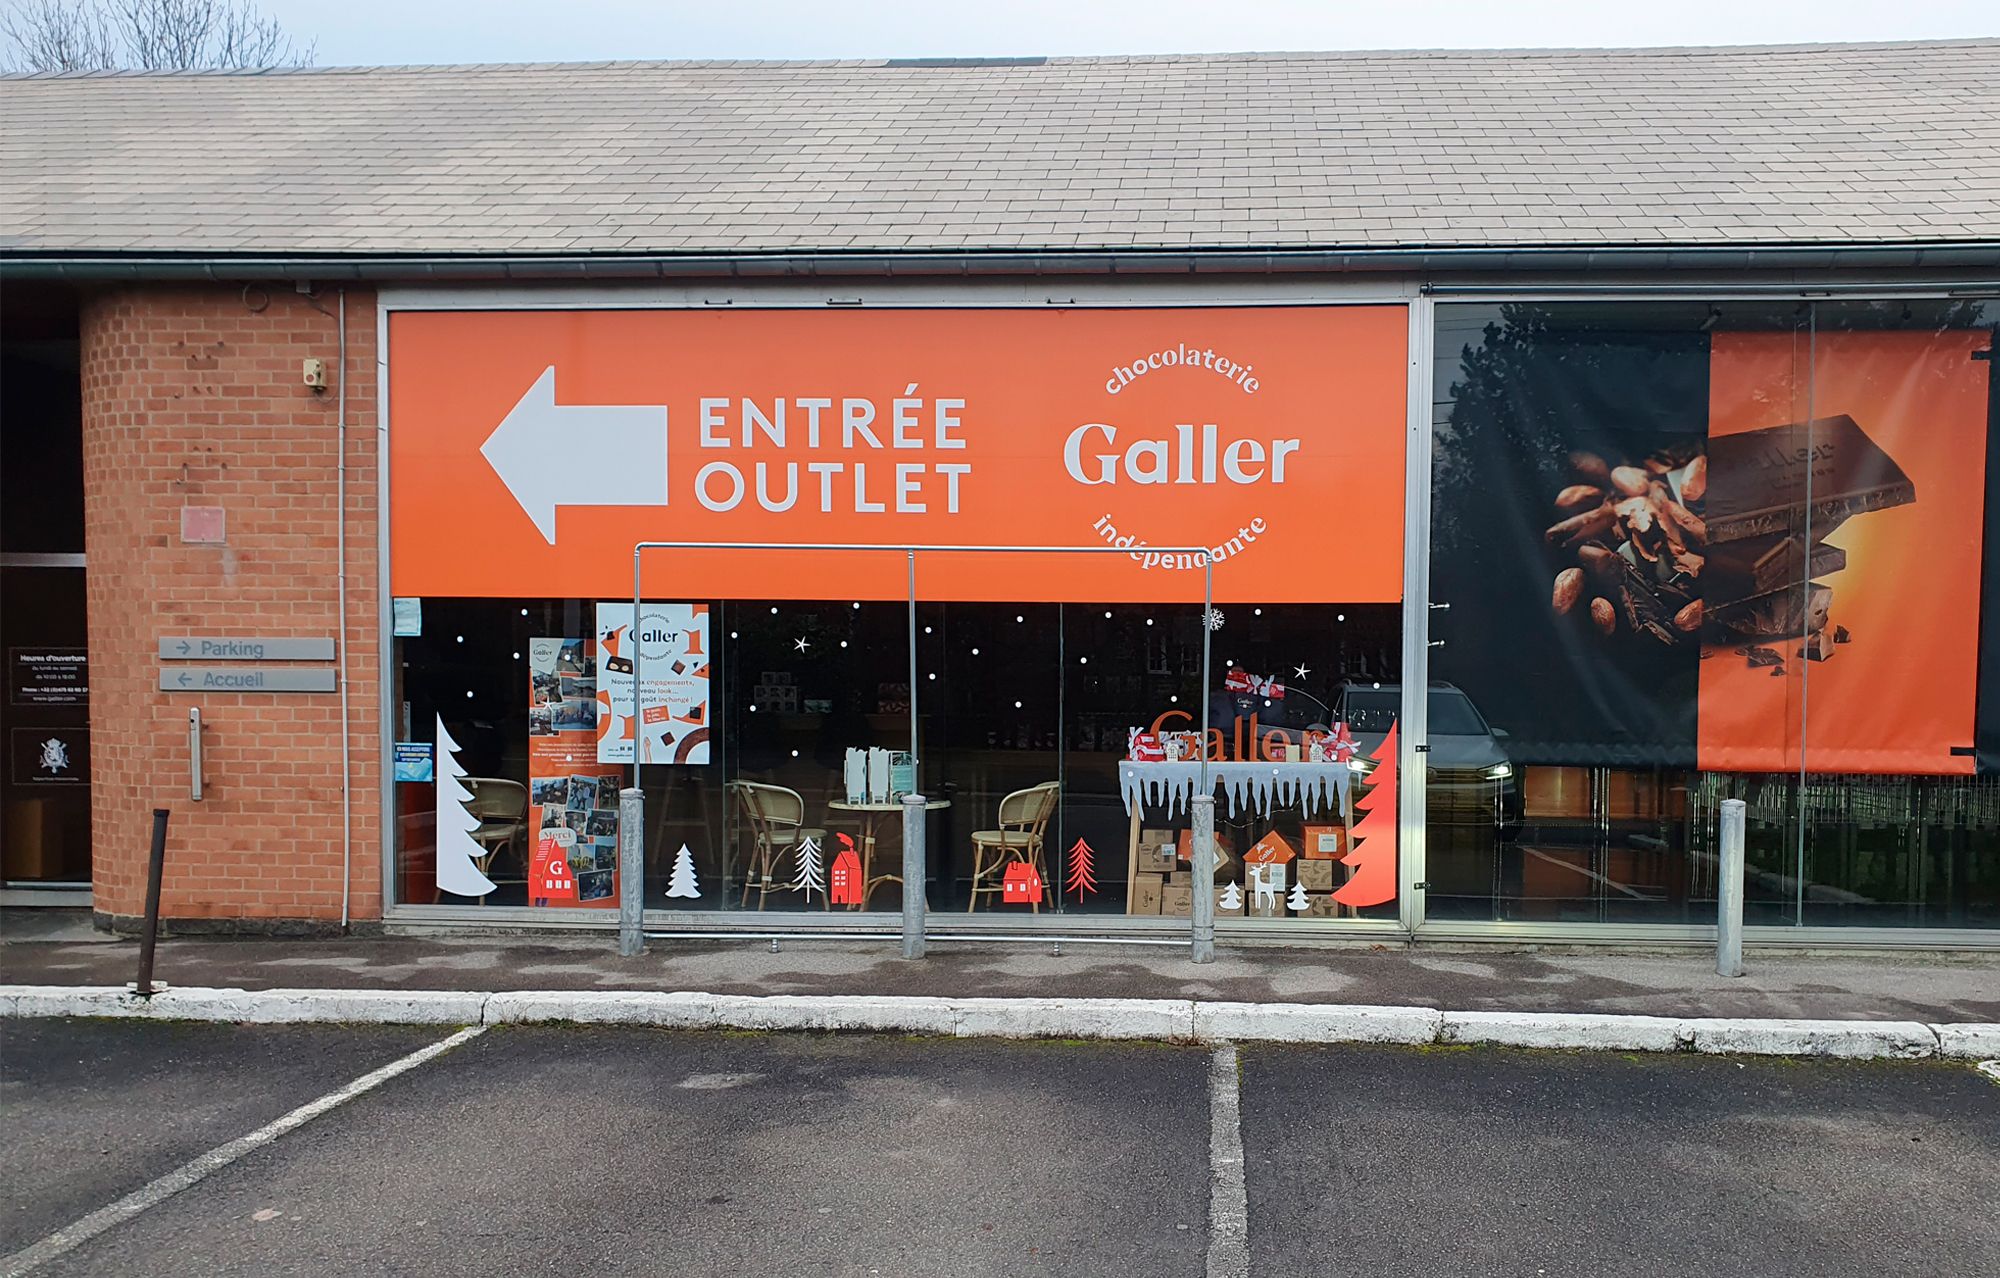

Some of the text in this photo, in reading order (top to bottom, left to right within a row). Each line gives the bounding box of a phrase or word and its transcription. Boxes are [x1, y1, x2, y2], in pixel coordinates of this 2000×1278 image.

[1105, 343, 1260, 394] chocolaterie
[700, 382, 966, 449] ENTRÉE
[1063, 423, 1300, 485] Galler
[694, 461, 972, 514] OUTLET
[201, 640, 264, 659] Parking
[203, 671, 264, 687] Accueil
[641, 696, 657, 704] goût
[1150, 710, 1324, 762] Galler
[550, 861, 563, 875] G
